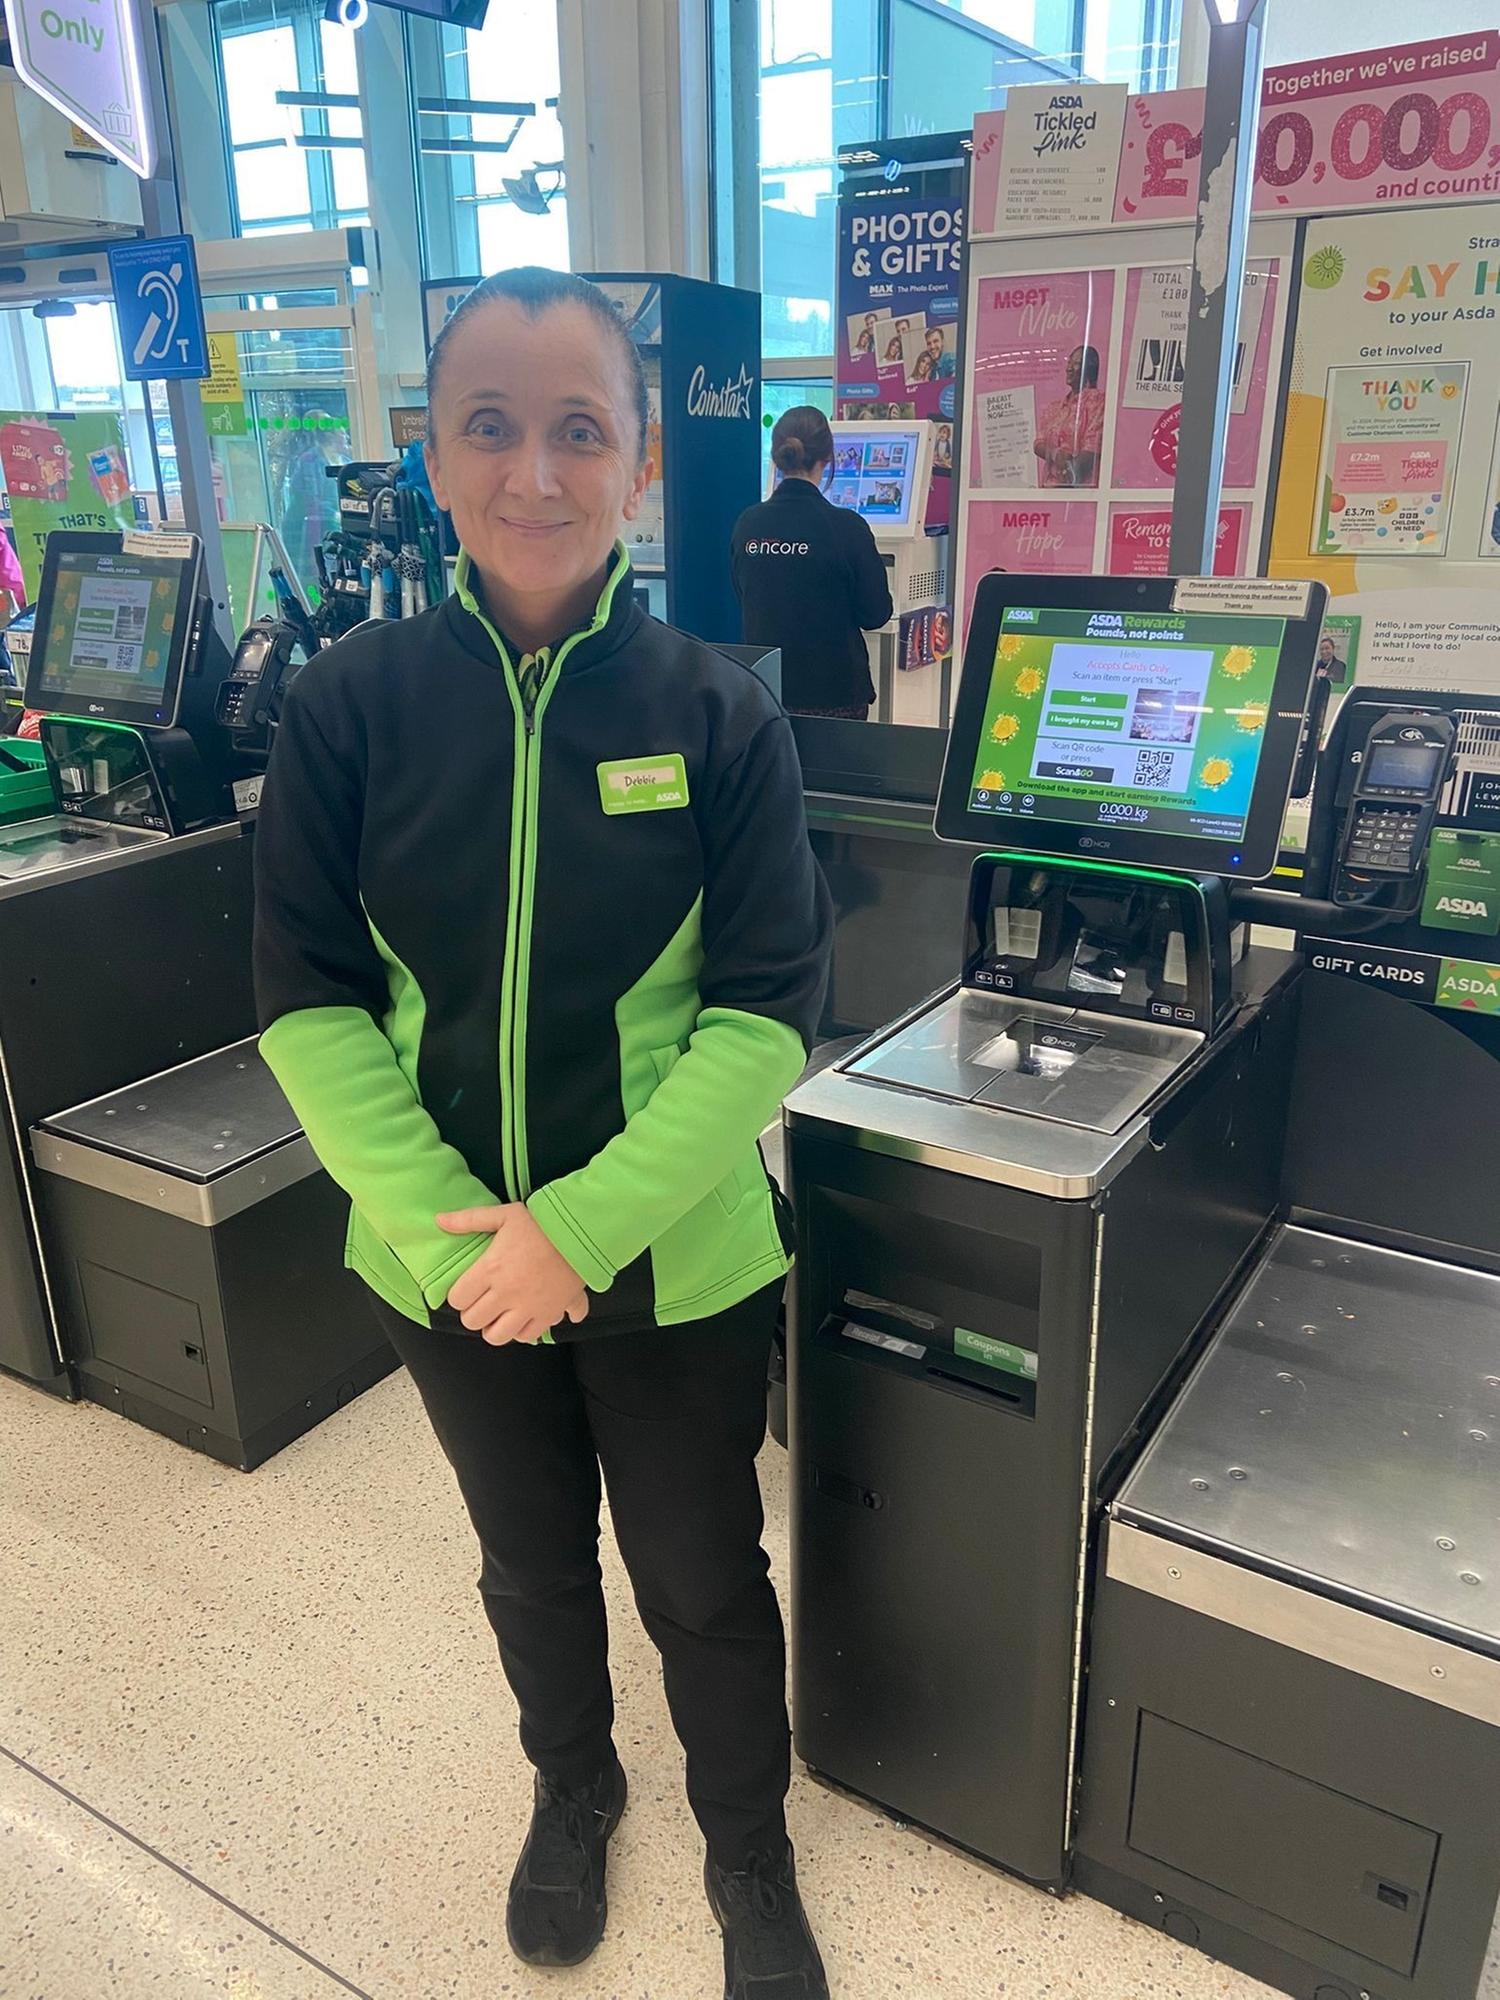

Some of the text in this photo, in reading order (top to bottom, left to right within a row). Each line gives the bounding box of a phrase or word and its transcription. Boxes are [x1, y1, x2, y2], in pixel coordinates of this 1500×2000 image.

[40, 9, 104, 52] Only
[1266, 41, 1488, 95] Together we've raised
[1049, 95, 1083, 108] ASDA
[1034, 111, 1096, 131] Tickled
[1033, 127, 1086, 158] Pink
[1376, 180, 1417, 199] and
[1469, 237, 1500, 249] Stra
[851, 248, 871, 277] &
[1152, 273, 1183, 285] TOTAL
[1363, 262, 1461, 301] SAY
[869, 284, 894, 294] MAX
[928, 284, 949, 292] Expert
[1018, 302, 1079, 337] Moke
[1161, 310, 1182, 318] THANK
[1389, 306, 1495, 325] to your Asda
[1170, 323, 1187, 331] YOUR
[1359, 344, 1443, 357] Get involved
[688, 364, 745, 419] Coinstar
[1136, 382, 1172, 392] THE REAL
[1362, 379, 1436, 395] THANK
[1376, 396, 1418, 411] YOU
[1350, 453, 1380, 462] £7.2m
[1410, 451, 1431, 459] ASDA
[1401, 459, 1439, 469] Tickled
[1345, 507, 1375, 517] £3.7m
[1016, 523, 1065, 559] Hope
[1148, 536, 1163, 548] TO
[746, 541, 809, 555] encore
[1007, 609, 1034, 621] ASDA
[1088, 614, 1186, 630] ASDA Rewards
[1375, 621, 1401, 629] Hello,
[1448, 622, 1500, 632] Community
[1085, 627, 1184, 641] Pounds, not points
[1393, 632, 1442, 641] supporting
[1382, 641, 1404, 649] what
[1411, 642, 1431, 650] love
[1445, 643, 1461, 651] do!
[1087, 661, 1170, 673] Accepts Cards Only
[1072, 671, 1095, 680] Scan
[1095, 673, 1104, 681] an
[1104, 673, 1120, 682] item
[1132, 676, 1154, 685] press
[1155, 676, 1182, 686] "Start"
[1080, 695, 1096, 703] Start
[1054, 717, 1079, 726] brought
[1105, 719, 1118, 728] bag
[1052, 741, 1104, 752] Scan QR code
[1070, 755, 1091, 763] press
[1055, 766, 1094, 778] Scan&GO
[624, 775, 656, 787] Debbie
[656, 791, 681, 802] ASDA
[1017, 780, 1197, 806] Download the app and start earning Rewards
[1099, 802, 1133, 816] 0.000
[1134, 804, 1149, 821] kg
[1437, 831, 1457, 839] ASDA
[1094, 841, 1111, 849] NCR
[1457, 857, 1481, 867] ASDA
[1435, 896, 1488, 917] ASDA
[1312, 955, 1425, 985] GIFT CARDS
[1443, 976, 1498, 997] ASDA
[1057, 1039, 1077, 1048] NCR
[852, 1327, 881, 1344] Receipt
[966, 1335, 1010, 1358] Coupons
